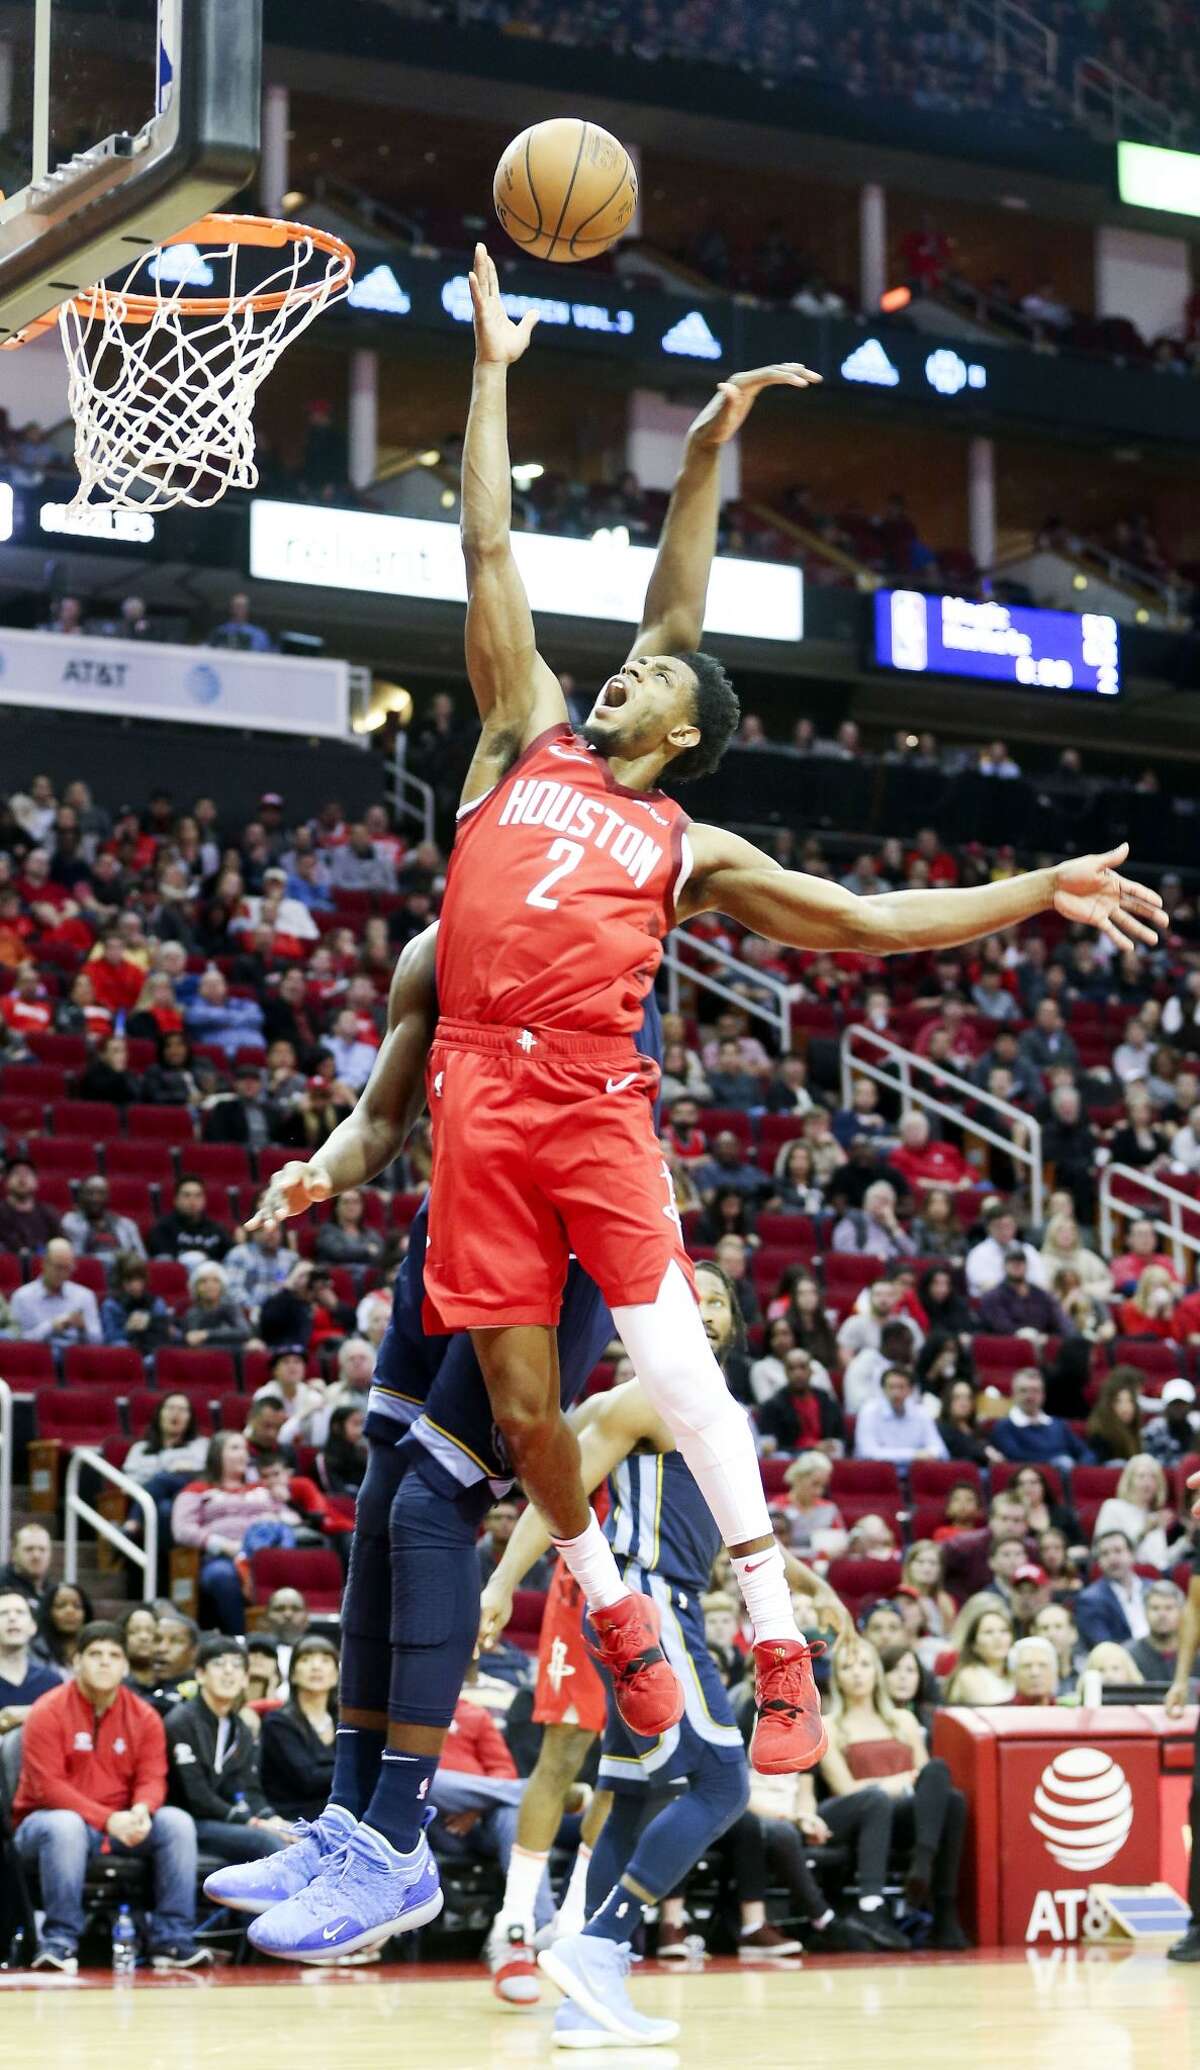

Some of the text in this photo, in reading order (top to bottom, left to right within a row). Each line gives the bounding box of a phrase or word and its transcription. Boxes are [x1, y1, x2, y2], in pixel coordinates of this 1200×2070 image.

[63, 659, 129, 688] AT&T
[498, 779, 664, 889] HOUSTON
[525, 837, 585, 911] 2
[1025, 1887, 1111, 1943] AT&
